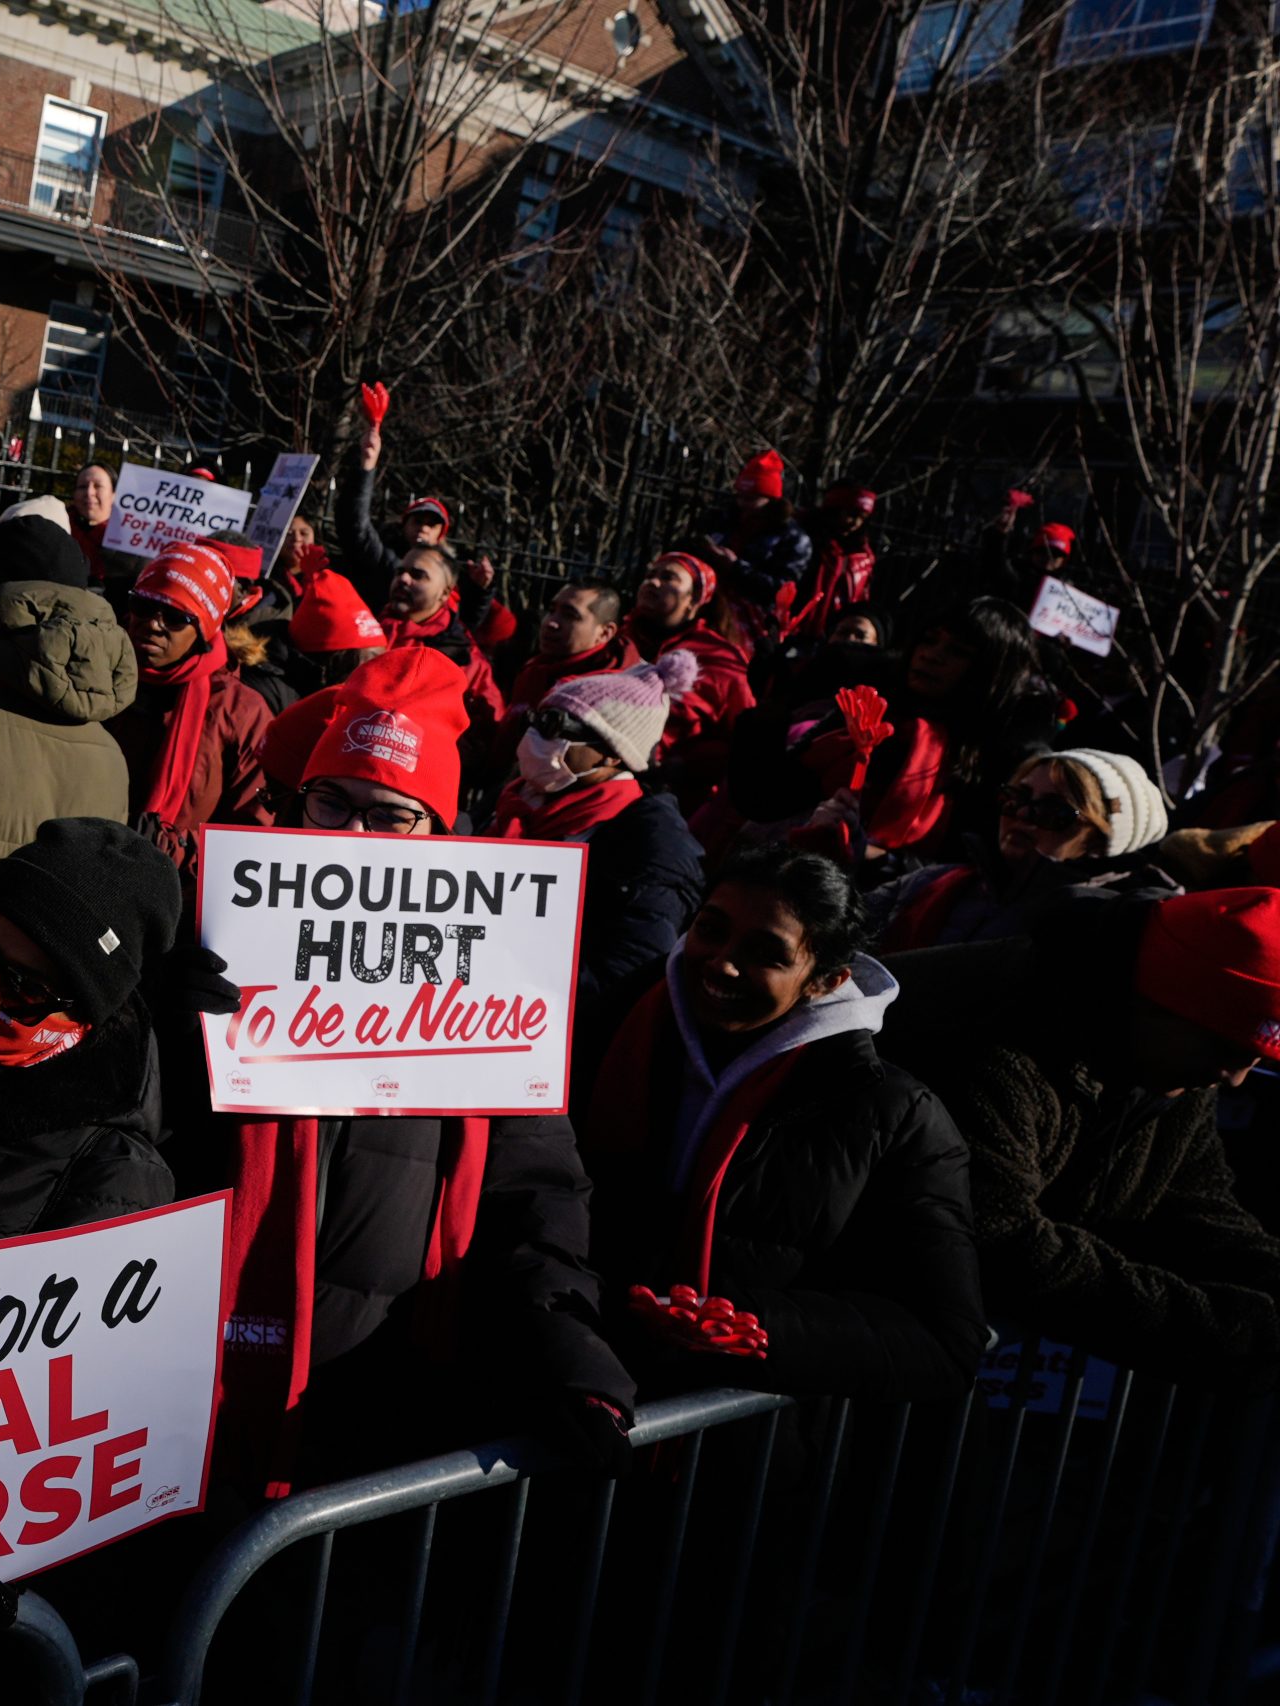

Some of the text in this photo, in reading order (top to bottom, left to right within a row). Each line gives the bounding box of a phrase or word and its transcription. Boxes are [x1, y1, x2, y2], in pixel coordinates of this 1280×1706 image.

[120, 494, 239, 532] CONTRACT
[156, 480, 204, 507] FAIR
[121, 513, 150, 532] For
[129, 533, 143, 547] &
[231, 859, 558, 917] SHOULDN'T
[294, 919, 486, 986] HURT
[224, 977, 549, 1051] To be a Nurse
[100, 1258, 162, 1329] a
